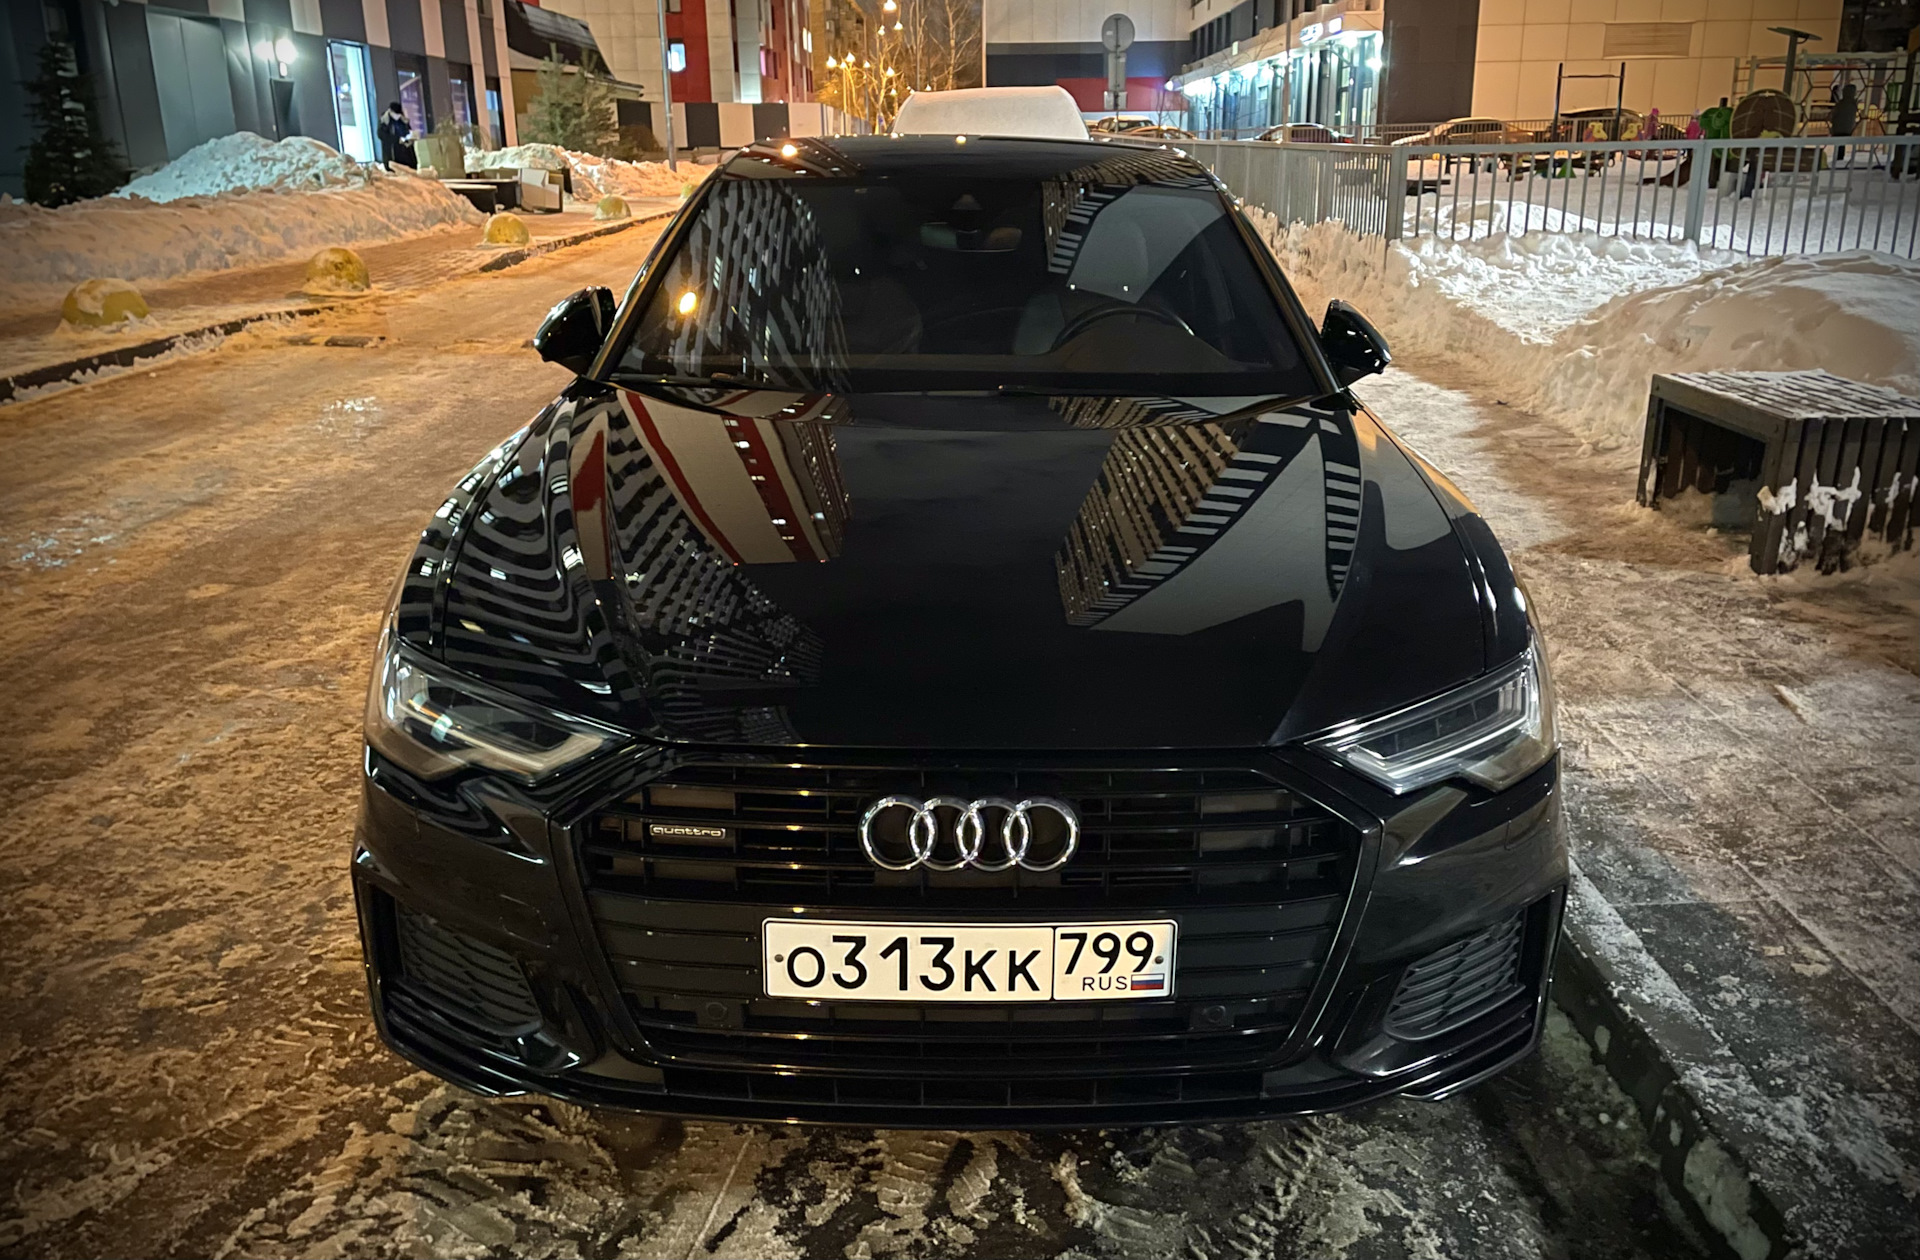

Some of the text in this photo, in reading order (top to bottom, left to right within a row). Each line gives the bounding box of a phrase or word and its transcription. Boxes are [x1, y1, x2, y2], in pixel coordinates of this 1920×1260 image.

[652, 826, 722, 837] quattro
[1060, 931, 1155, 975] 799
[1082, 976, 1128, 991] RUS
